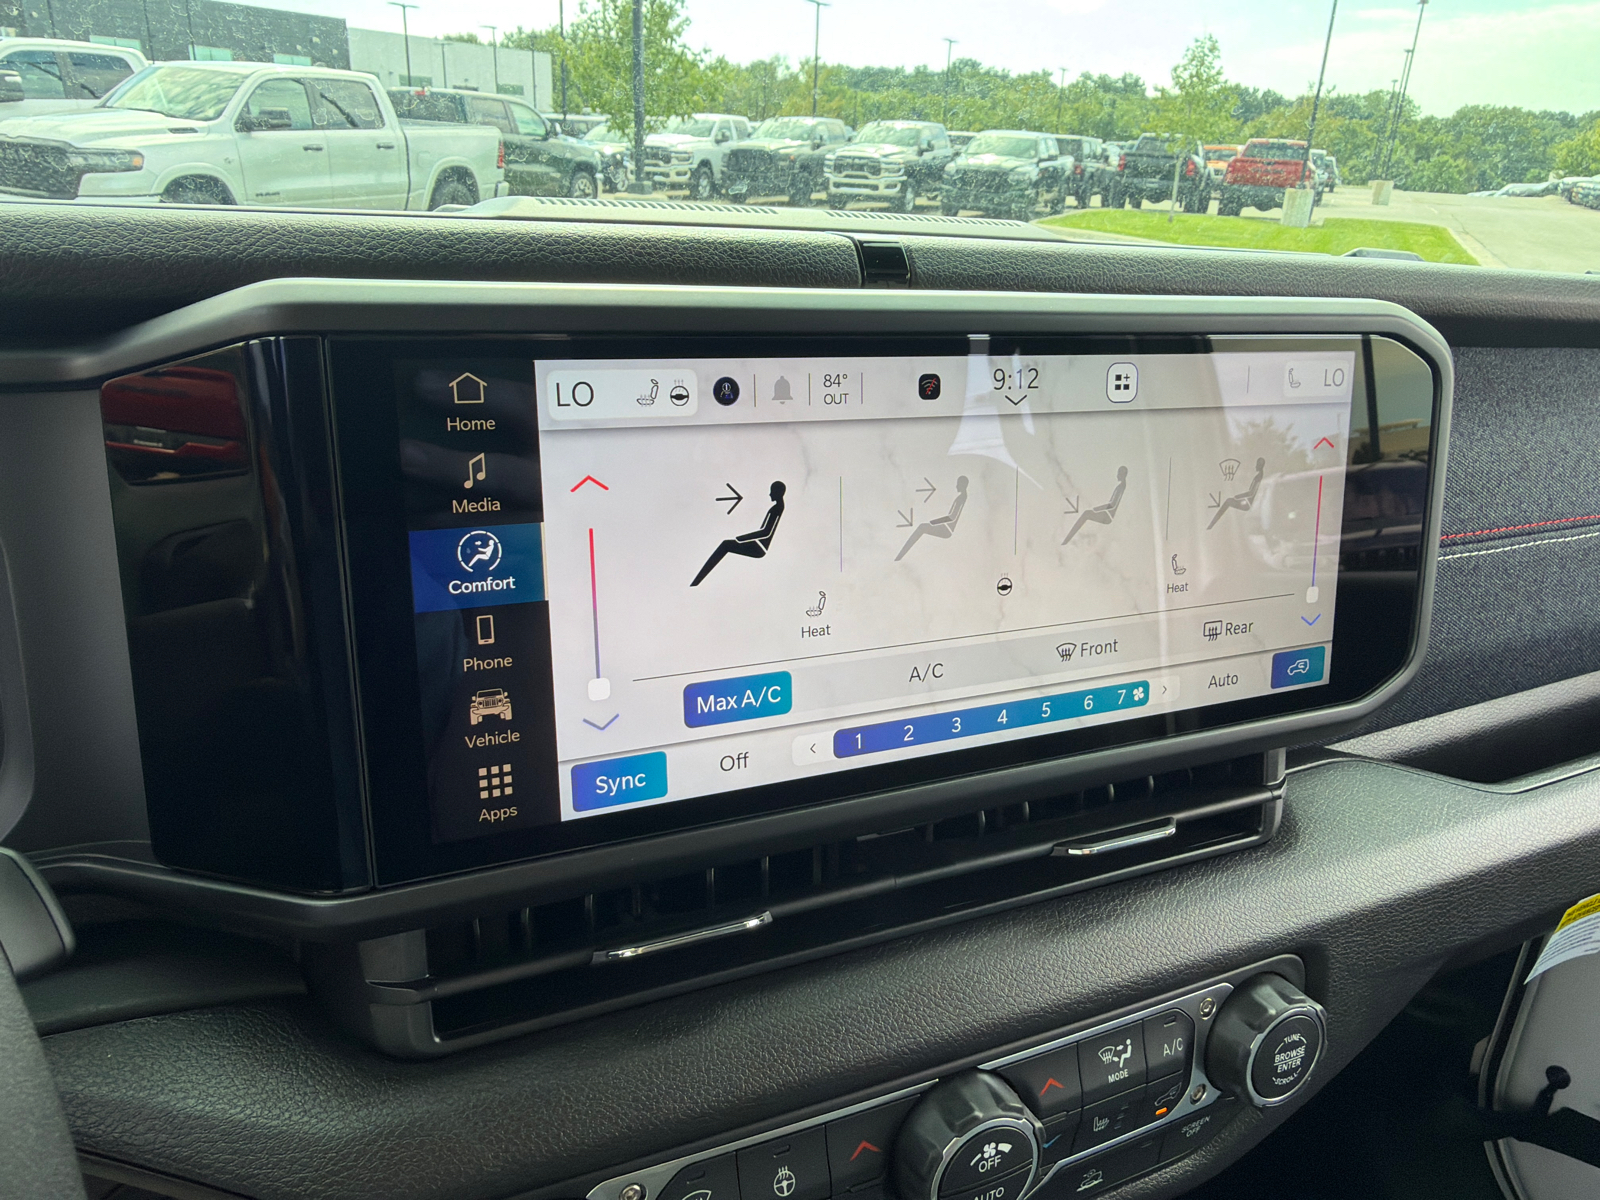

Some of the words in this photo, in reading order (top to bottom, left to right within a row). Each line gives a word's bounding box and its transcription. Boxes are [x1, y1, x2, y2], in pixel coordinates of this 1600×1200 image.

[822, 373, 849, 388] 84°
[993, 367, 1039, 390] 9:12
[1323, 367, 1345, 387] LO
[555, 381, 594, 407] LO
[823, 393, 849, 405] OUT
[446, 416, 496, 431] Home
[452, 498, 501, 513] Media
[448, 576, 516, 594] Comfort
[1166, 582, 1189, 594] Heat
[801, 624, 831, 638] Heat
[1225, 620, 1254, 636] Rear
[1080, 638, 1118, 657] Front
[463, 656, 513, 672] Phone
[908, 663, 944, 682] A/C
[1208, 672, 1239, 689] Auto
[697, 694, 738, 714] Max
[741, 685, 781, 708] A/C
[855, 733, 863, 749] 1
[903, 725, 914, 741] 2
[951, 717, 962, 733] 3
[997, 709, 1008, 724] 4
[1041, 702, 1051, 718] 5
[1083, 695, 1094, 710] 6
[1117, 690, 1127, 705] 7
[464, 729, 521, 748] Vehicle
[719, 752, 749, 772] Off
[595, 772, 646, 796] Sync
[478, 805, 518, 823] Apps
[1163, 1037, 1183, 1057] A/C
[1284, 1033, 1301, 1044] TUNE
[1274, 1045, 1306, 1063] BROWSE
[1277, 1058, 1302, 1073] ENTER
[1108, 1068, 1129, 1083] MODE
[1181, 1115, 1211, 1134] SCREEN
[1186, 1125, 1202, 1138] OFF
[978, 1154, 1002, 1173] OFF
[973, 1186, 1005, 1200] UTO
